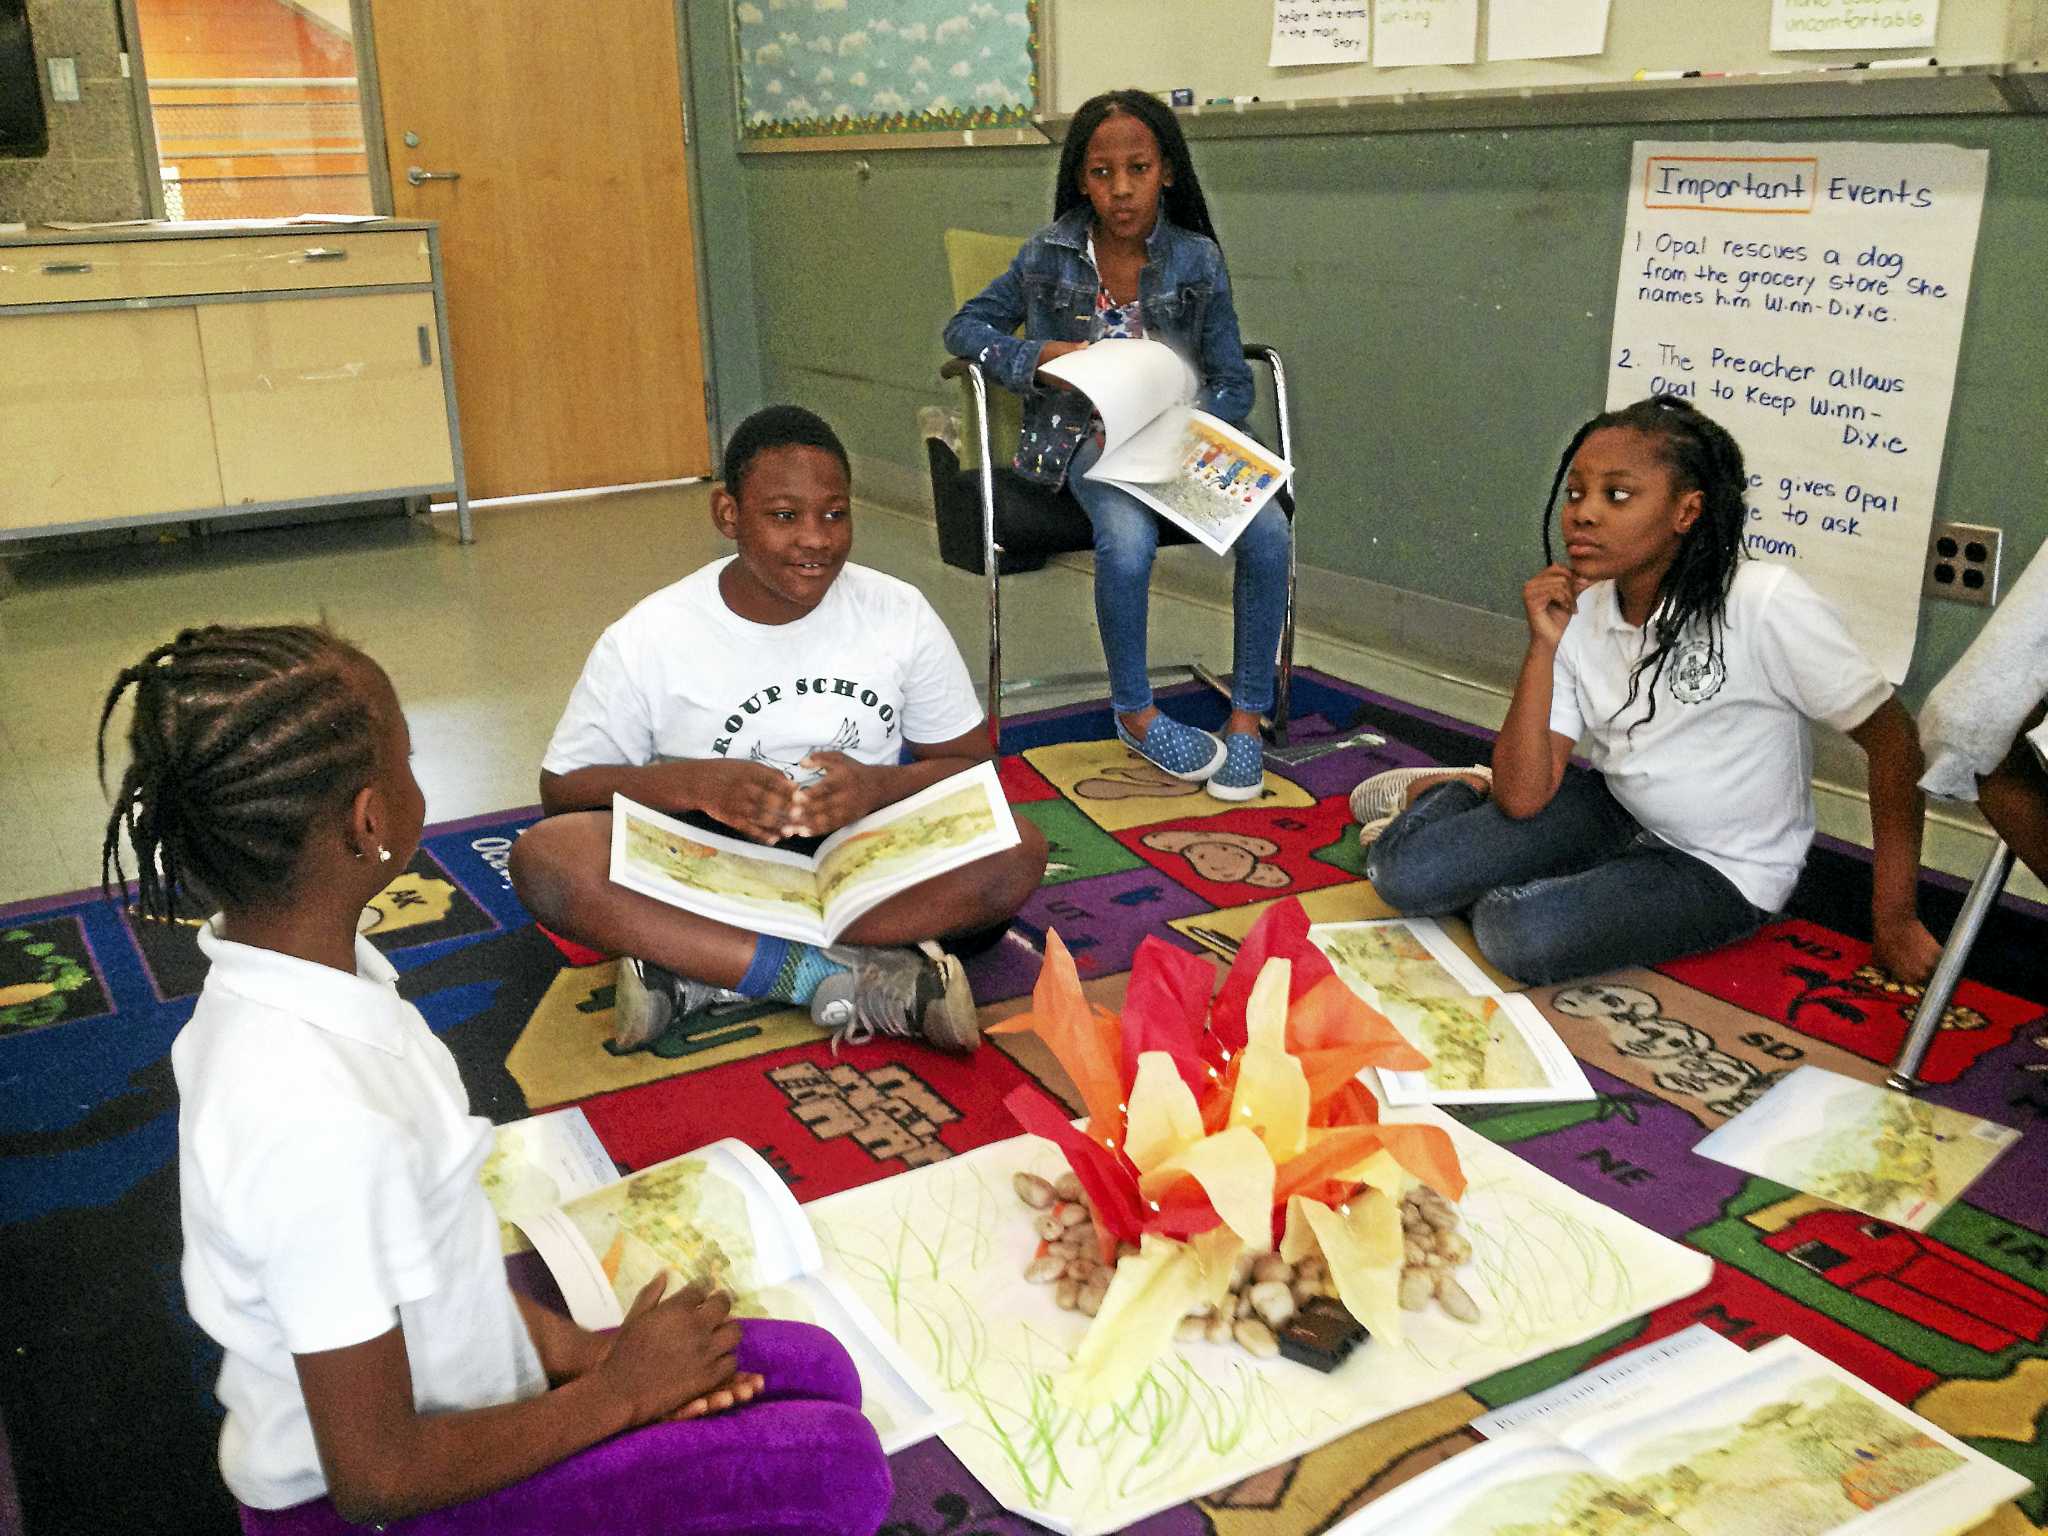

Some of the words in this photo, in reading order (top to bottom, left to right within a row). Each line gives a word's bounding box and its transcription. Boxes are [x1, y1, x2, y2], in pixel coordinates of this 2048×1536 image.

[1785, 9, 1924, 33] uncomfortable
[1656, 167, 1806, 202] Important
[1828, 177, 1933, 208] Events
[1655, 232, 1706, 261] Opal
[1722, 239, 1809, 264] rescues
[1823, 248, 1841, 265] a
[1856, 245, 1904, 278] dog
[1641, 258, 1687, 282] from
[1694, 264, 1729, 284] the
[1739, 268, 1816, 295] grocery
[1638, 286, 1704, 306] names
[1715, 287, 1751, 309] him
[1657, 342, 1695, 372] The
[1711, 347, 1815, 380] Preacher
[1828, 365, 1905, 393] allows
[1650, 376, 1696, 397] Opal
[1710, 378, 1735, 400] to
[1810, 397, 1882, 422] Winn-
[1842, 424, 1908, 454] Dixie
[1779, 475, 1837, 502] gives
[1845, 484, 1898, 513] Opal
[1782, 502, 1809, 526] to
[1821, 513, 1863, 537] ask
[711, 685, 783, 758] ROUP
[1738, 1032, 1805, 1061] SD
[1576, 1145, 1657, 1186] NE
